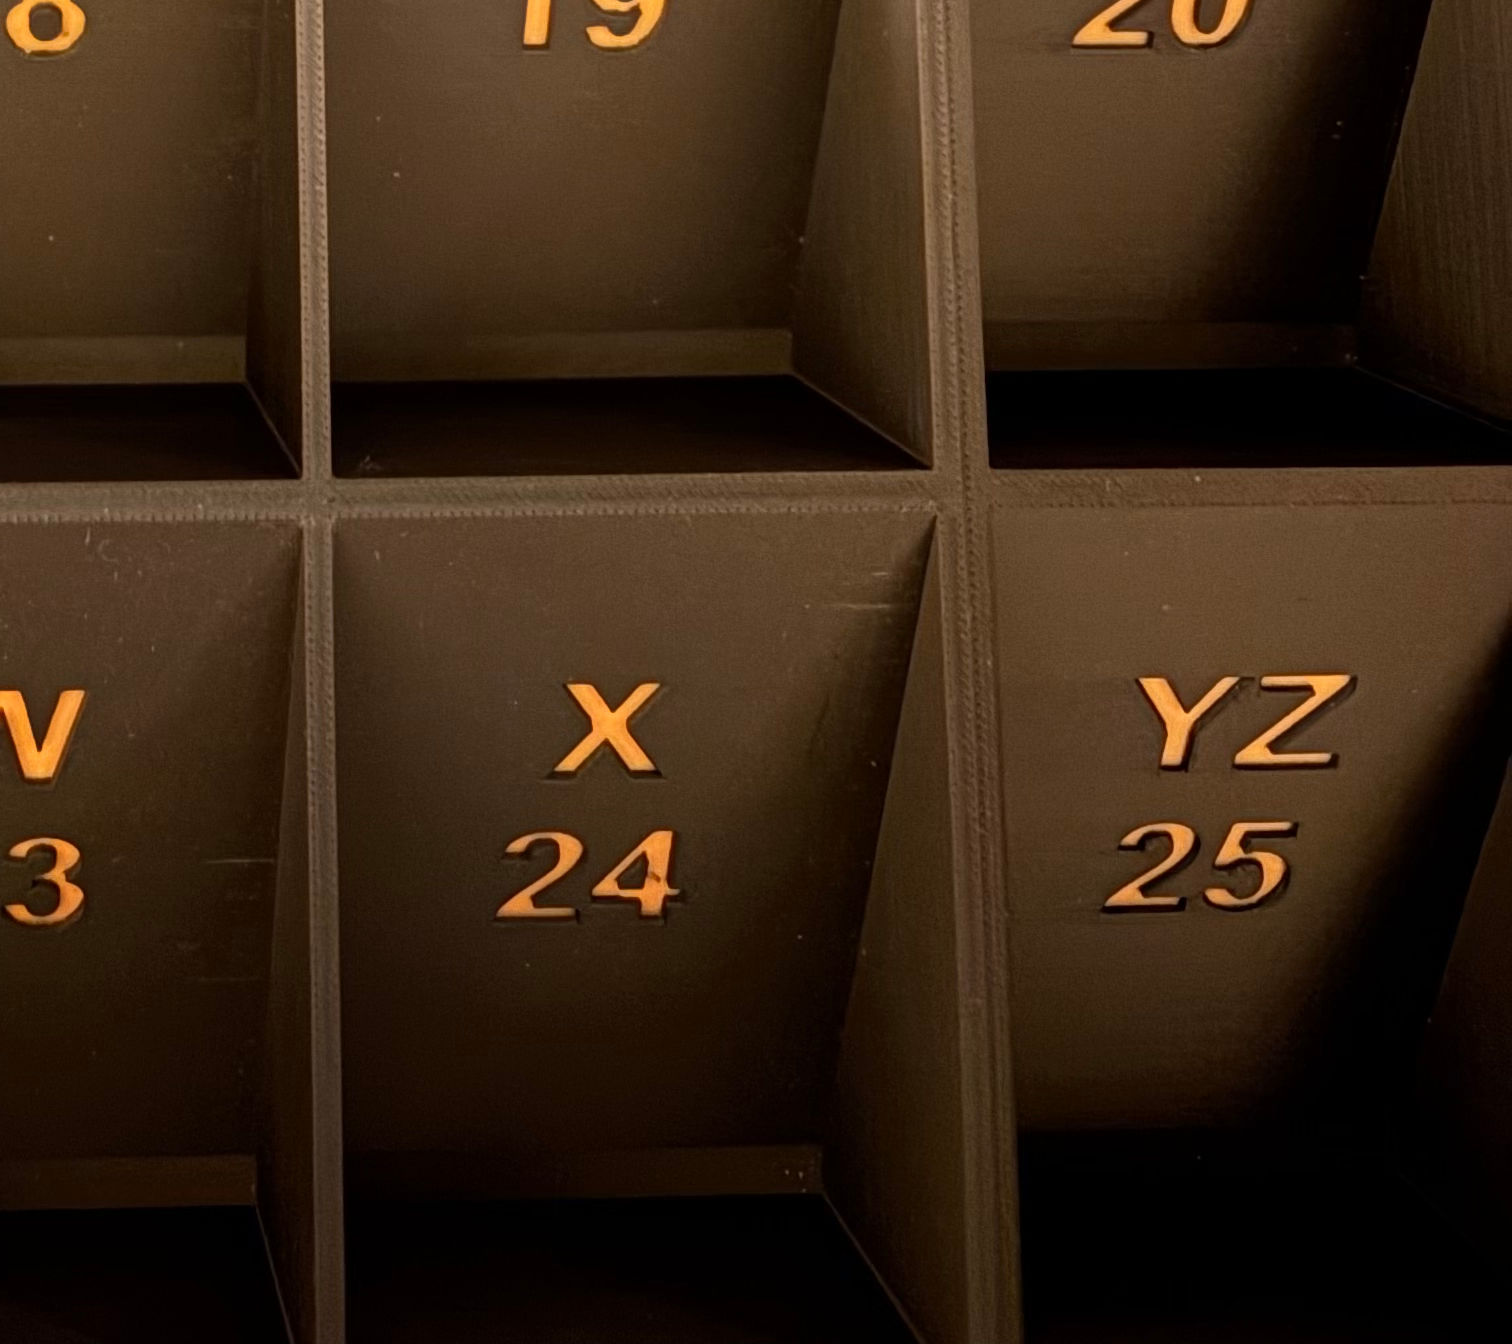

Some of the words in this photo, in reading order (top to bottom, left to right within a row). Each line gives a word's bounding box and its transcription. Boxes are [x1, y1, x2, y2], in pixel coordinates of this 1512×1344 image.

[554, 681, 661, 774] X
[1140, 673, 1350, 767] YZ
[497, 829, 679, 919] 24
[1106, 822, 1292, 910] 25
